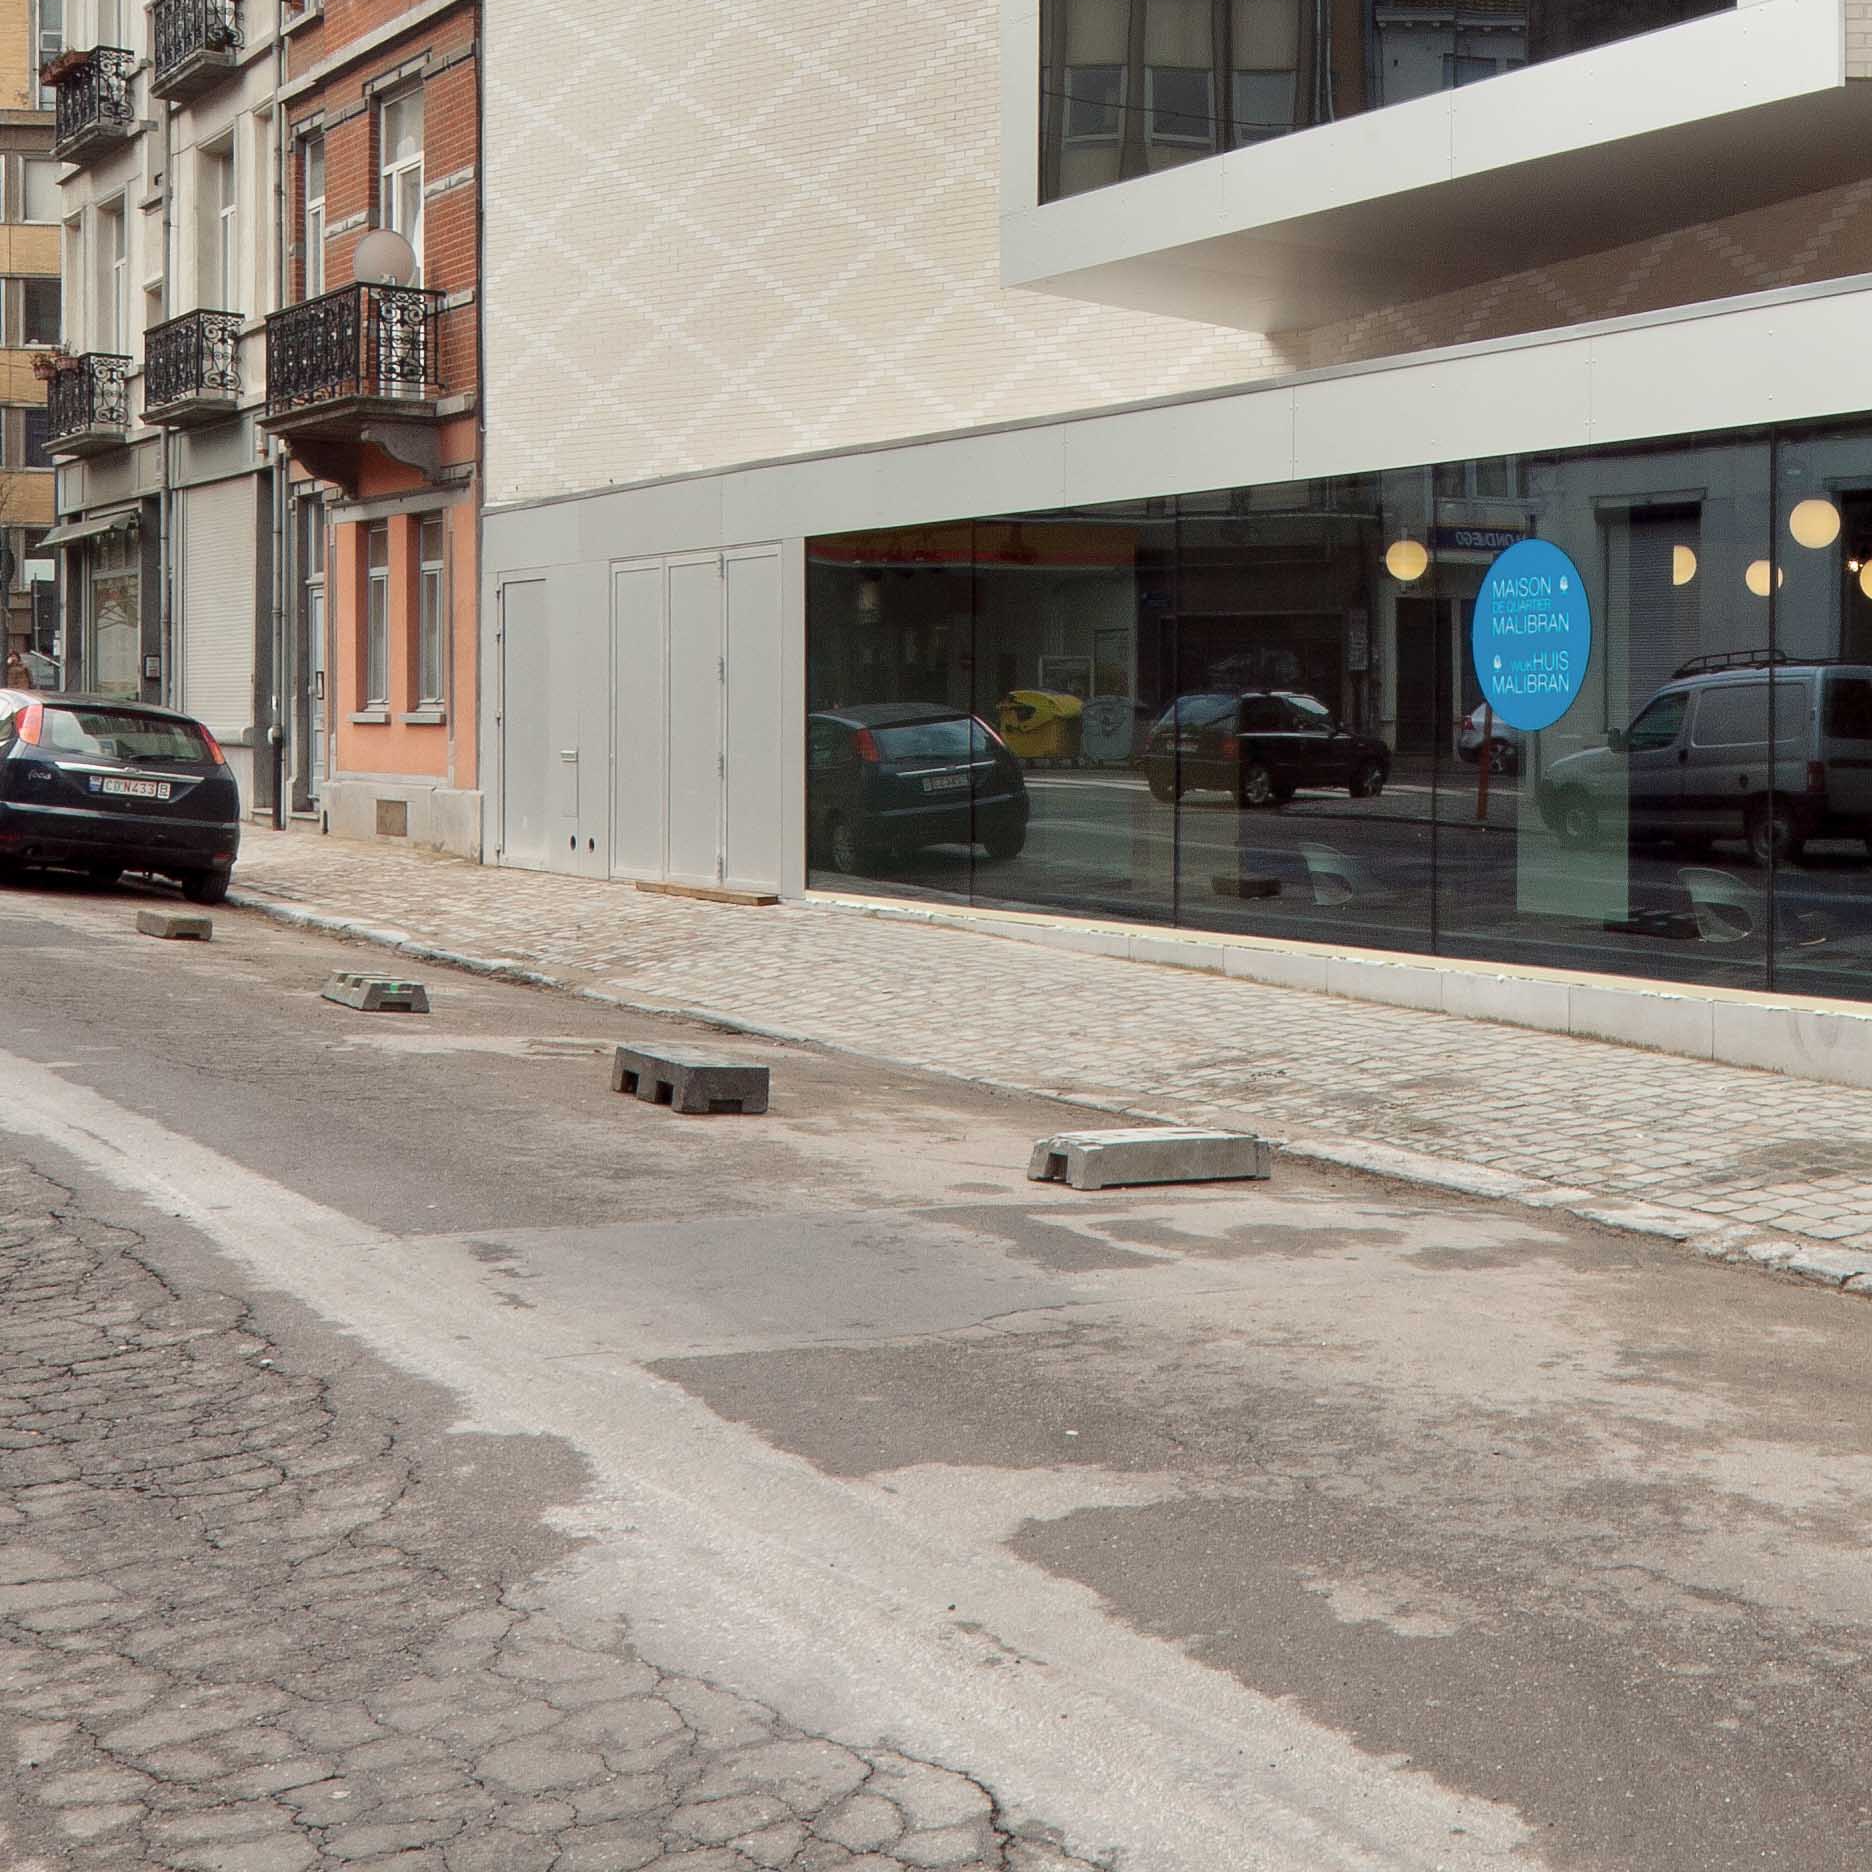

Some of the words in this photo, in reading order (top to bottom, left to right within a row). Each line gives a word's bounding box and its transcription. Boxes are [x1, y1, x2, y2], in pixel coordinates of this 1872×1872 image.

[1493, 576, 1551, 598] MAISON
[1492, 601, 1505, 614] DE
[1506, 599, 1552, 613] QUARTIER
[1492, 613, 1569, 636] MALIBRAN
[1492, 674, 1569, 696] MALIBRAN
